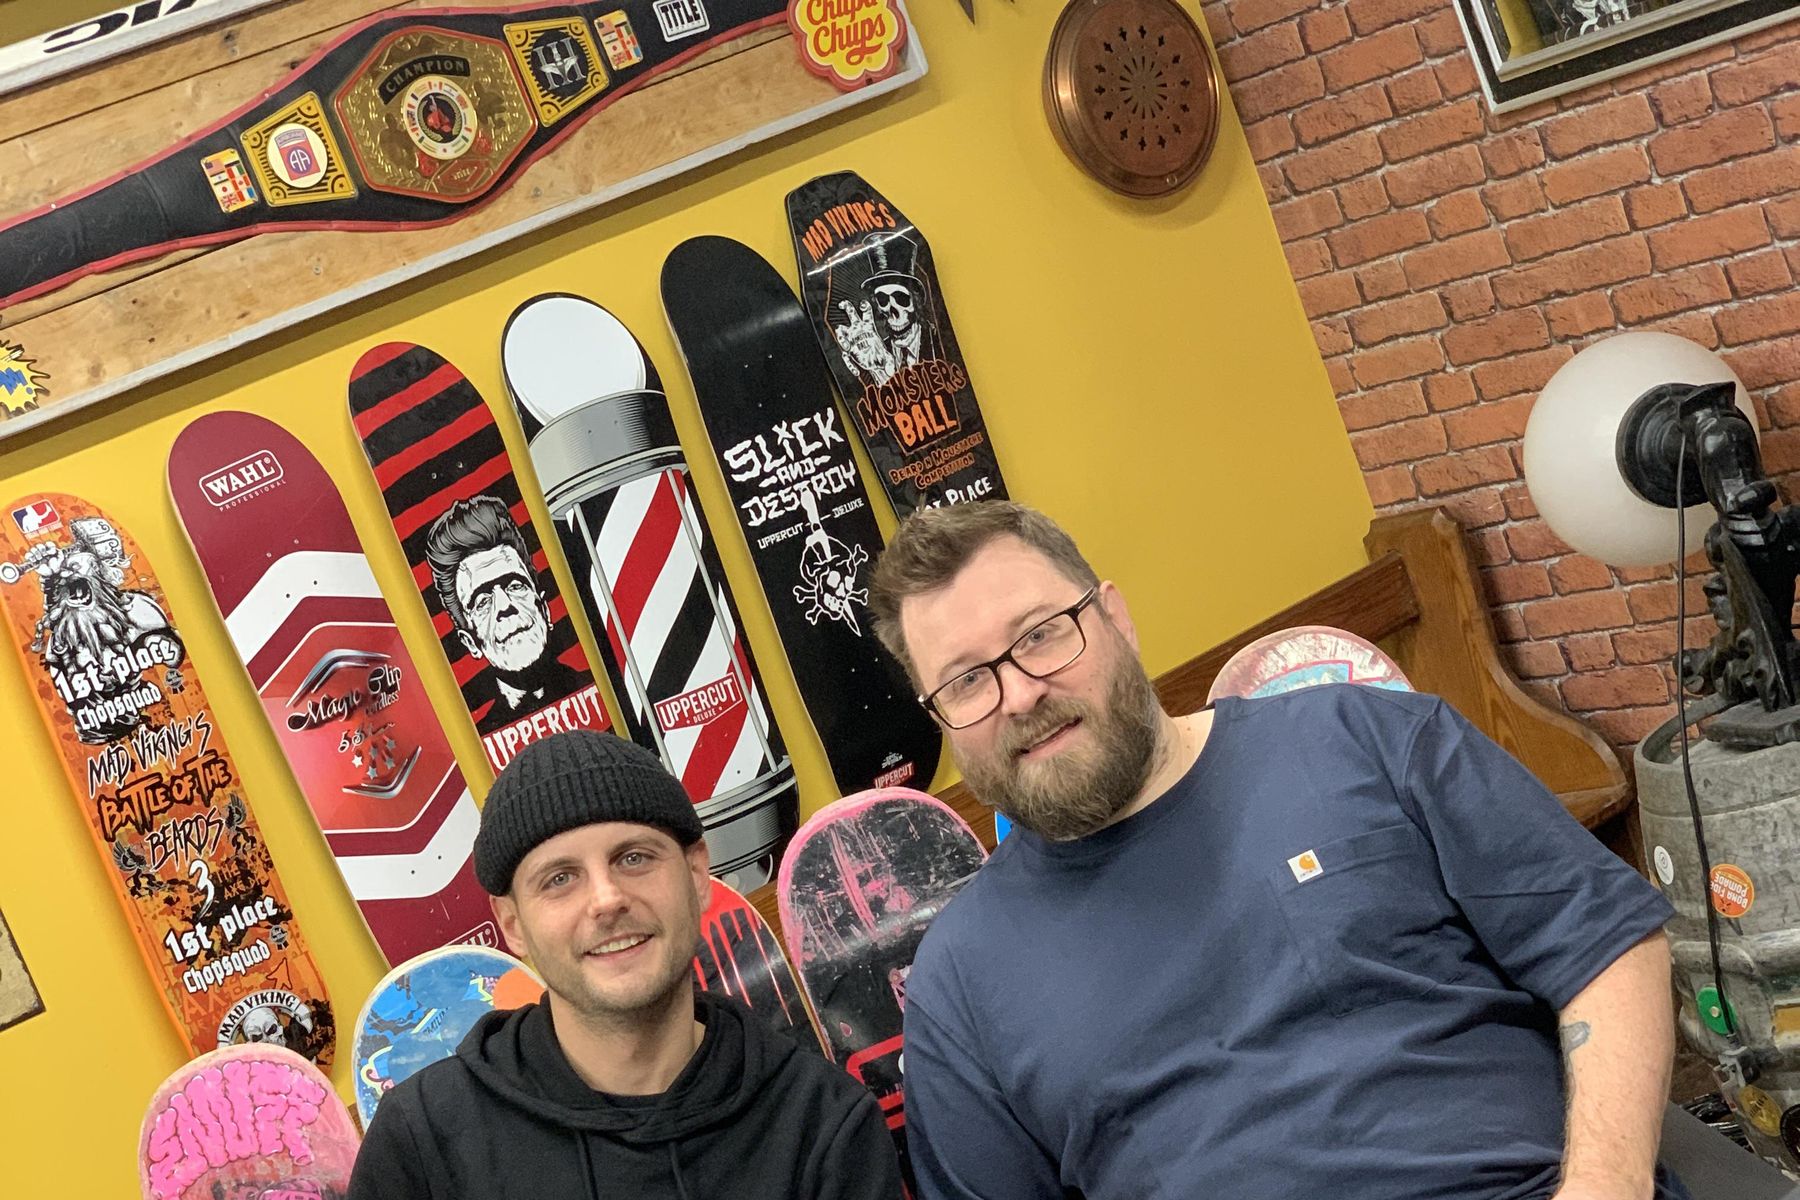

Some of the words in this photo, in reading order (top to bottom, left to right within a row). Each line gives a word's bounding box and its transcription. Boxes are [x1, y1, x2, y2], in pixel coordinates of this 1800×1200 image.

[660, 0, 701, 28] TITLE
[813, 14, 886, 65] Chups
[386, 60, 465, 93] CHAMPION
[802, 218, 834, 263] MAD
[857, 358, 967, 437] MONSTERS
[894, 395, 957, 447] BALL
[723, 407, 844, 482] SLICK
[889, 461, 924, 485] BEARD
[931, 431, 984, 466] MOUSTACHE
[205, 459, 276, 497] WAHL
[219, 479, 287, 512] PROFESSIONAL
[741, 459, 856, 527] DESTROY
[915, 452, 976, 490] COMPETITION
[945, 477, 993, 506] PLACE
[757, 523, 804, 549] UPPERCUT
[832, 498, 865, 518] DELUXE
[54, 662, 106, 703] 1st
[111, 639, 176, 685] place
[286, 687, 361, 732] Magic
[367, 664, 402, 695] Clip
[660, 678, 737, 728] UPPERCUT
[692, 708, 717, 723] DELUXE
[483, 685, 604, 771] UPPERCUT
[87, 744, 132, 799] MAD
[98, 773, 172, 841] BATTLE
[171, 775, 195, 805] OF
[183, 750, 232, 807] THE
[874, 761, 913, 789] UPPERCUT
[144, 806, 226, 872] BEARDS
[188, 858, 215, 920] 3
[1715, 873, 1749, 897] POMADE
[165, 922, 213, 962] 1st
[219, 896, 278, 942] place
[219, 1006, 245, 1038] MAD
[244, 991, 297, 1009] VIKING
